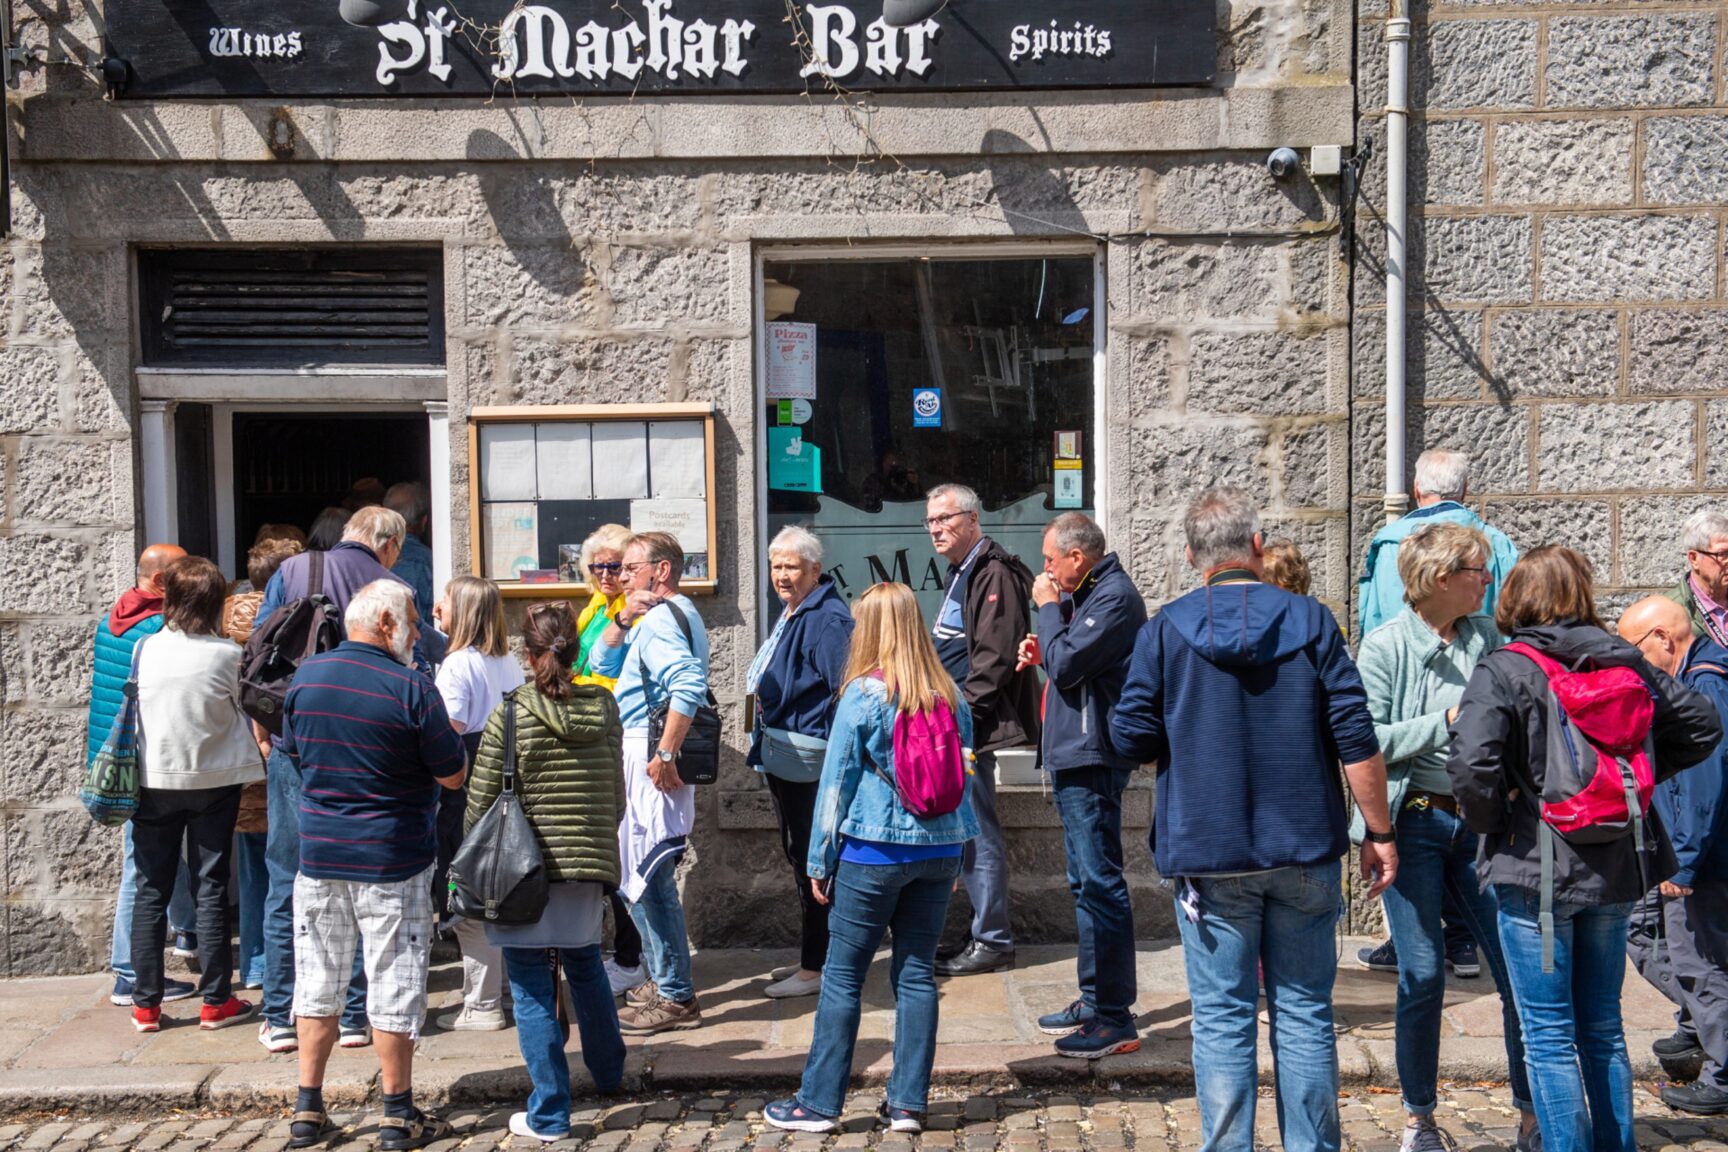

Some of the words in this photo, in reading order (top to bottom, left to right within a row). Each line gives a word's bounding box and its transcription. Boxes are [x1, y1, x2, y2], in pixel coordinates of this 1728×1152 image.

[209, 27, 302, 58] Wines
[376, 0, 457, 85] St
[491, 0, 756, 80] Machar
[799, 3, 940, 78] Bar
[1009, 18, 1112, 61] Spirits
[774, 328, 808, 340] Pizza
[649, 510, 690, 521] Postcards
